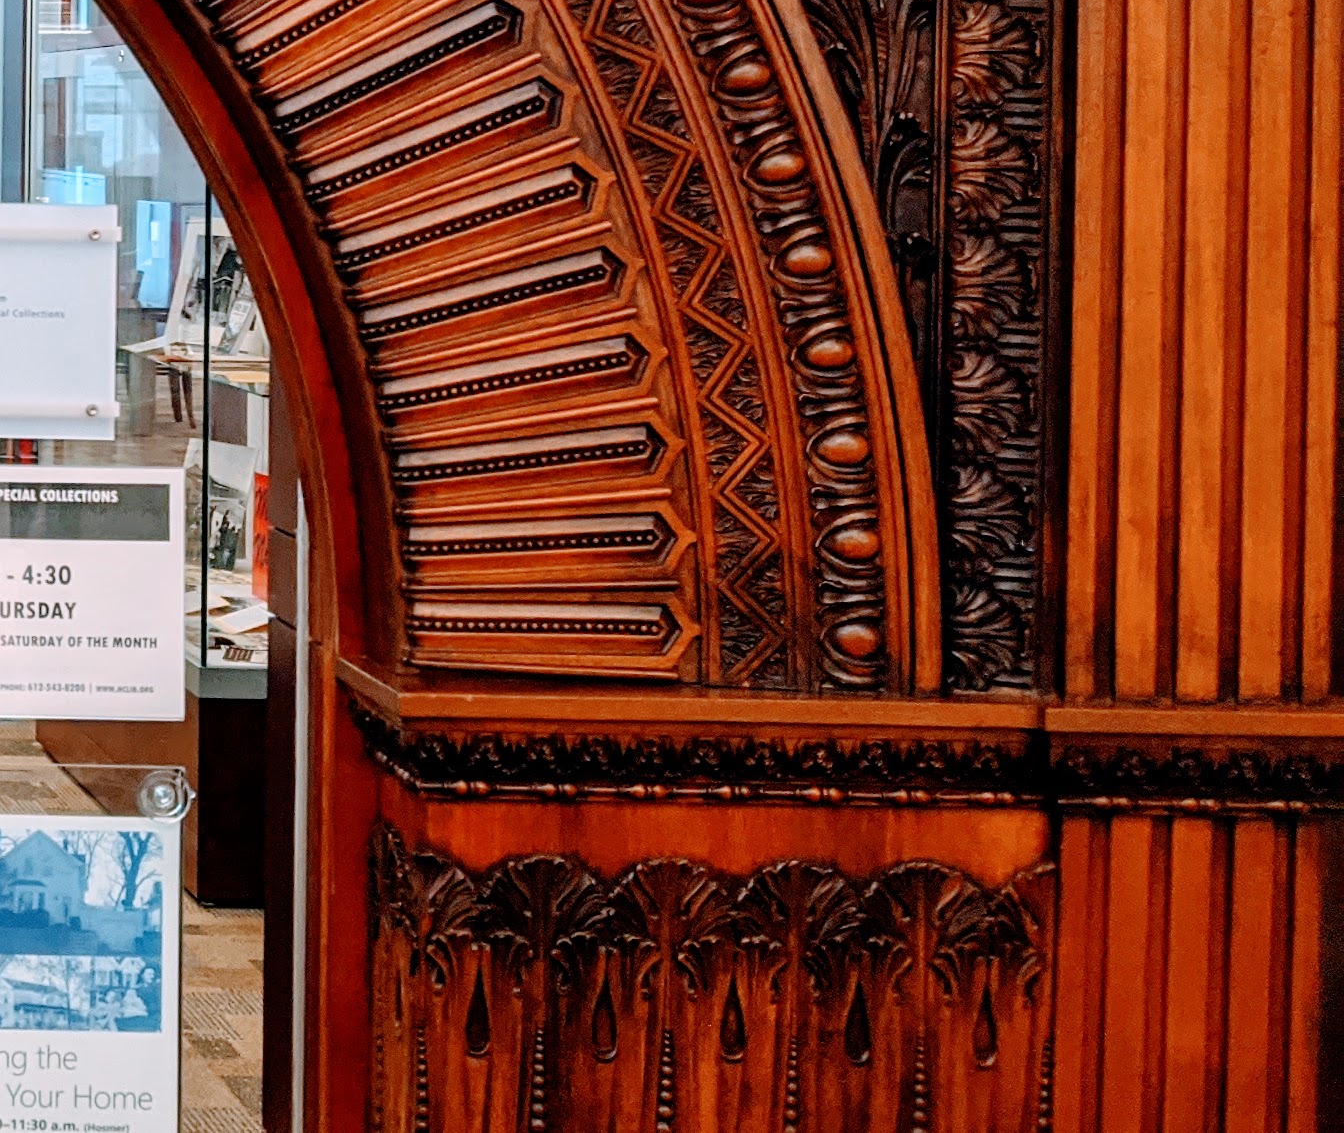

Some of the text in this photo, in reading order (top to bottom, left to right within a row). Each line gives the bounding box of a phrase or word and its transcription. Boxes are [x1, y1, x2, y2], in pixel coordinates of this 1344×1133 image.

[12, 309, 65, 319] Collections
[39, 489, 119, 504] COLLECTIONS
[22, 565, 72, 585] 4:30
[0, 634, 63, 648] SATURDAY
[67, 635, 83, 648] OF
[86, 636, 108, 648] THE
[112, 636, 158, 649] MONTH
[38, 1044, 78, 1071] the
[6, 1084, 64, 1109] Your
[74, 1085, 153, 1111] Home
[51, 1121, 79, 1132] a.m.
